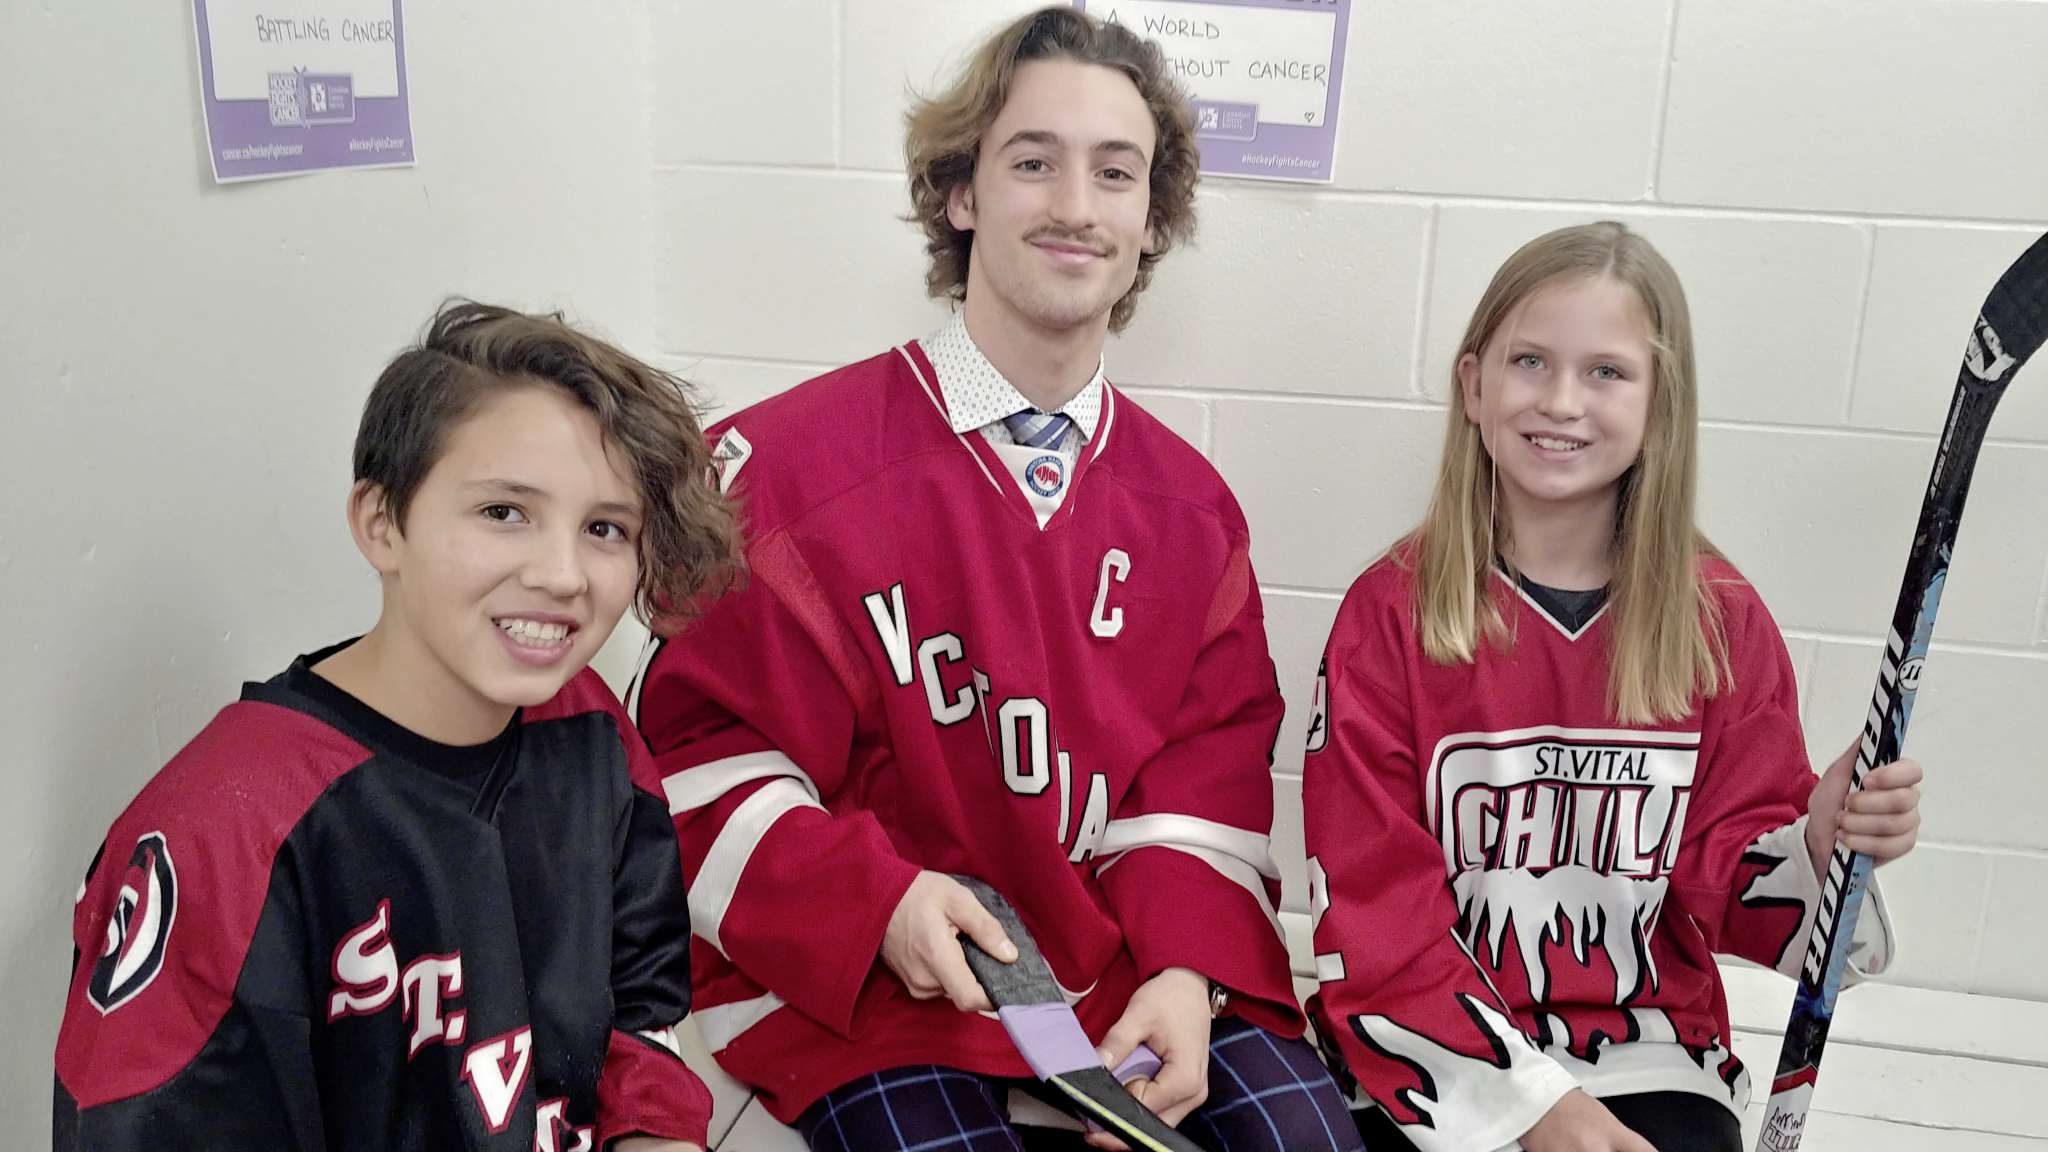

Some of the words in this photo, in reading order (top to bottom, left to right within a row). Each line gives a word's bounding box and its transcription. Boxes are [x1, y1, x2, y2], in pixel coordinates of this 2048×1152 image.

[256, 14, 331, 43] BATTLING
[341, 19, 395, 43] CANCER
[1143, 14, 1221, 40] WORLD
[1160, 56, 1230, 78] THOUT
[1248, 58, 1326, 86] CANCER
[1089, 547, 1131, 638] C
